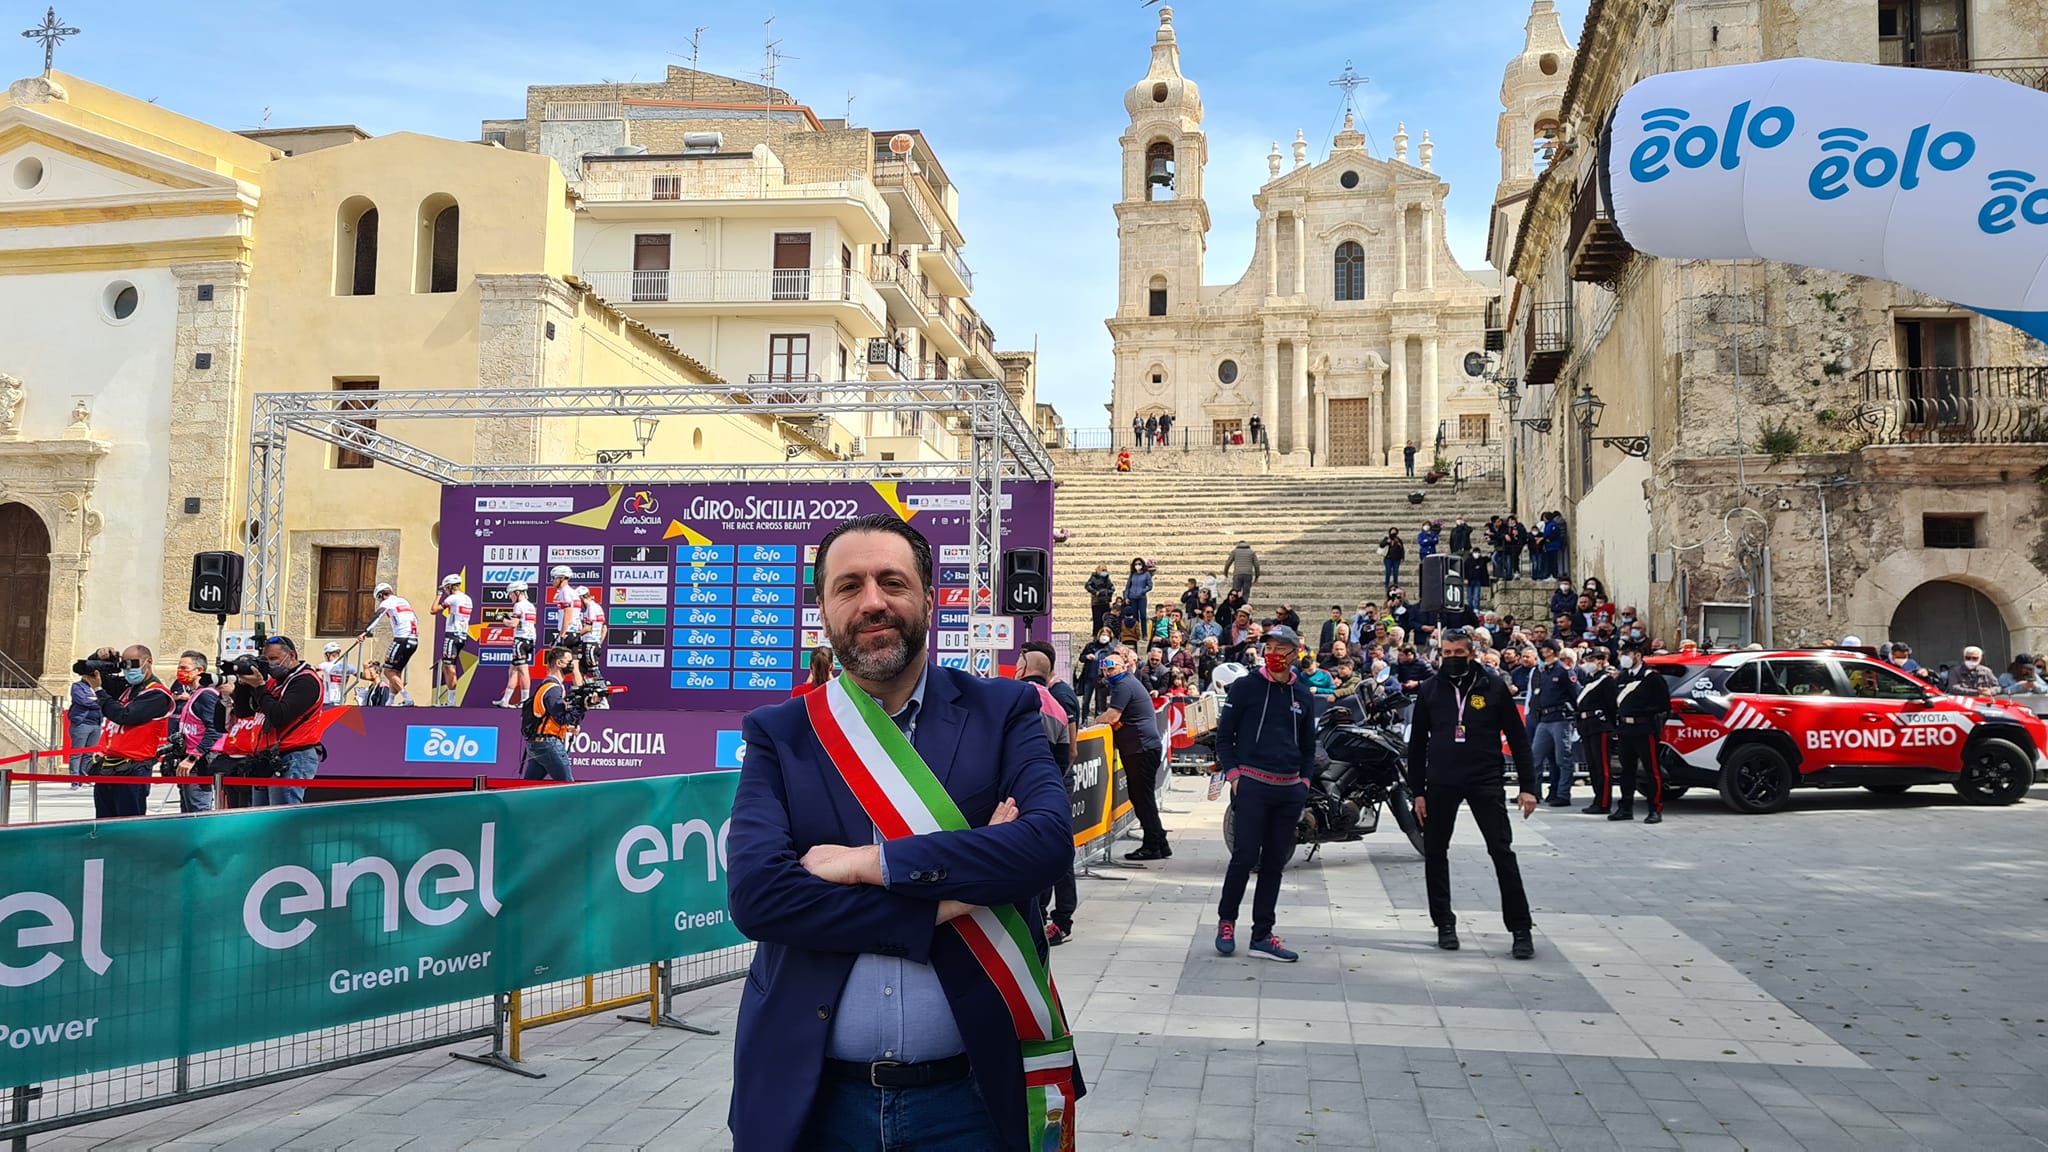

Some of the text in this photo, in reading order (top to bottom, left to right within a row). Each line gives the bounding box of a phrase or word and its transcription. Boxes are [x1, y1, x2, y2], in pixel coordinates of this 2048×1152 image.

[1630, 100, 1795, 183] eolo
[1808, 123, 1976, 200] eolo
[1977, 174, 2048, 234] eo
[690, 496, 734, 520] GIRO
[744, 496, 806, 520] SICILIA
[809, 499, 859, 520] 2022
[722, 521, 811, 530] THE RACE ACROSS BEAUTY
[490, 547, 528, 561] GOBIK
[566, 548, 601, 556] TISSOT
[692, 547, 719, 561] eolo
[753, 547, 781, 561] eolo
[485, 567, 535, 581] valsir
[613, 570, 665, 579] ITALIA.IT
[691, 568, 718, 582] eolo
[752, 568, 780, 582] eolo
[490, 590, 509, 599] TOY
[690, 589, 717, 603] eolo
[752, 589, 780, 604] eolo
[625, 609, 649, 619] enel
[689, 610, 716, 624] eolo
[751, 610, 779, 624] eolo
[941, 614, 969, 623] SHIM
[688, 631, 715, 645] eolo
[750, 631, 778, 646] eolo
[945, 633, 969, 646] GOB
[610, 653, 661, 663] ITALIA.IT
[687, 652, 714, 666] eolo
[749, 652, 777, 667] eolo
[686, 673, 714, 687] eolo
[748, 673, 777, 688] eolo
[1906, 713, 1949, 724] TOYOTA
[423, 728, 479, 760] eolo
[565, 728, 666, 755] RO DI SICILIA
[1806, 727, 1957, 749] BEYOND ZERO
[573, 758, 590, 766] RACE
[591, 758, 616, 767] ACROSS
[617, 758, 643, 767] BEAUTY
[615, 817, 728, 893] en
[242, 822, 503, 950] enel
[0, 858, 113, 988] el
[674, 909, 724, 931] Green
[329, 950, 492, 994] Green Power
